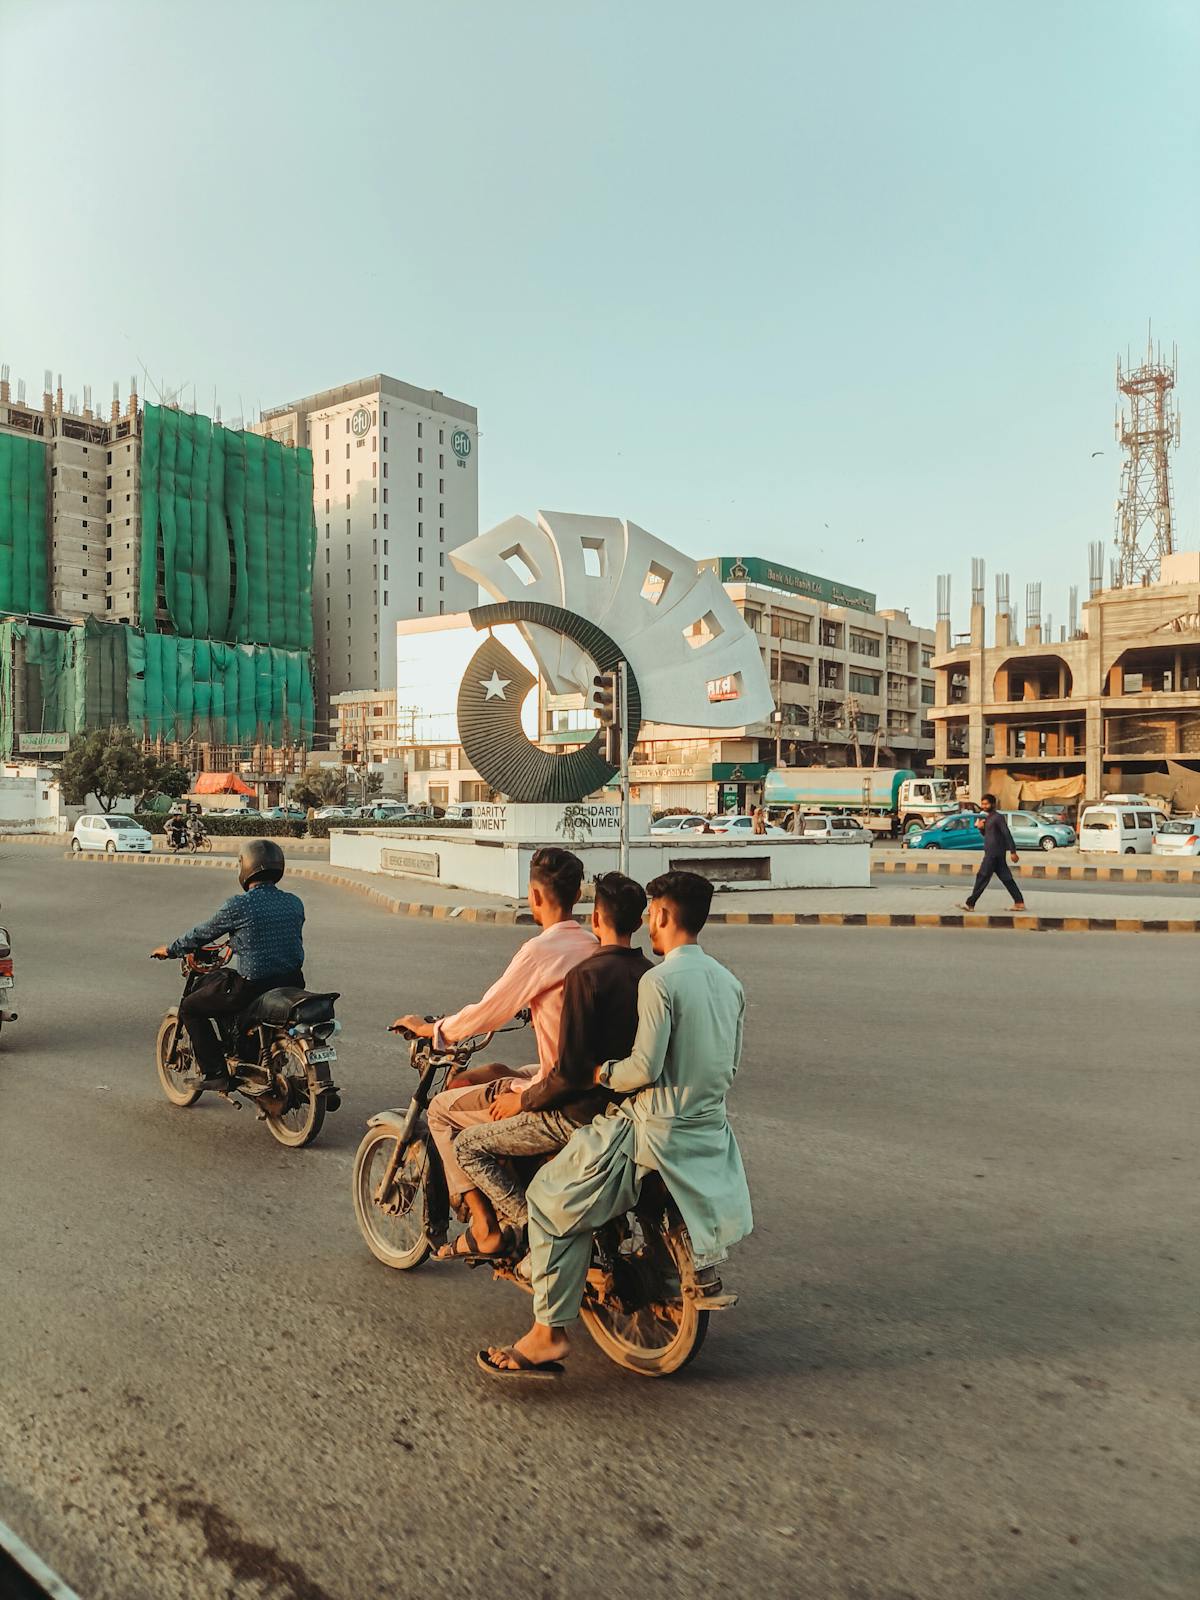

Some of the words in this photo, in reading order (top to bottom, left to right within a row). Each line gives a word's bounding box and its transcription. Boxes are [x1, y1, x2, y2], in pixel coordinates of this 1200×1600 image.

[353, 411, 368, 433] efu
[454, 434, 470, 454] efu
[767, 568, 783, 583] Bank
[794, 577, 811, 592] Habib
[565, 806, 620, 817] SOLIDARIT
[564, 818, 620, 828] MONUMEN
